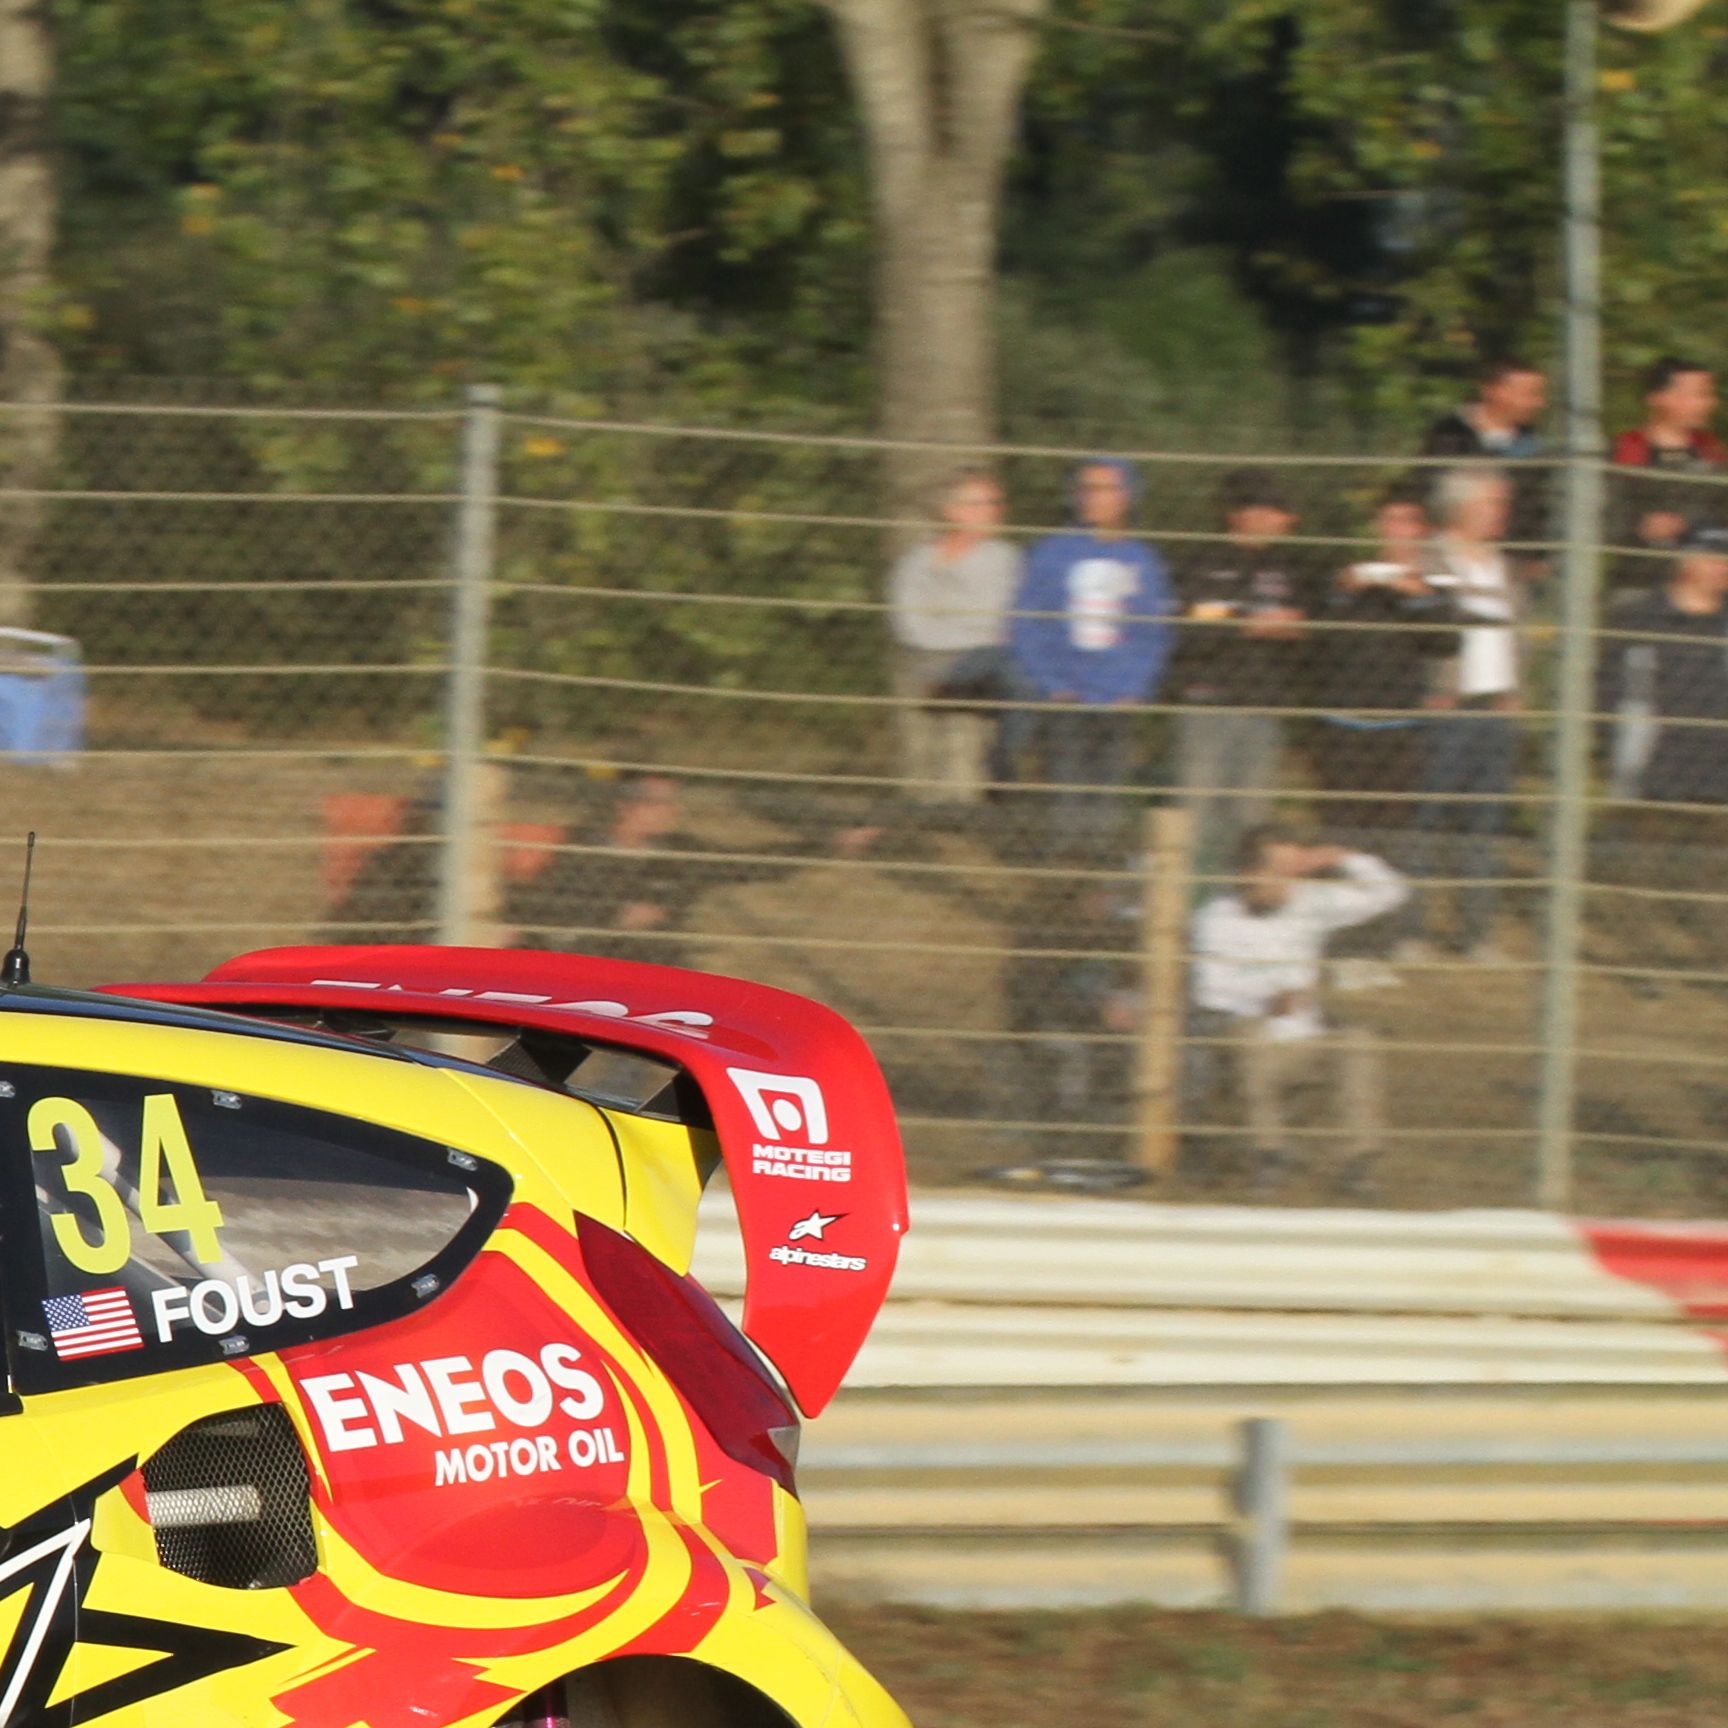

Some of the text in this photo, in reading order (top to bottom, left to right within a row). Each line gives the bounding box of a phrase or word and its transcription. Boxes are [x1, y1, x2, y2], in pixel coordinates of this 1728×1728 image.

[27, 1094, 224, 1274] 34
[752, 1143, 852, 1166] MOTEGI
[752, 1159, 852, 1182] RACING
[769, 1245, 867, 1271] alpinestars
[152, 1255, 359, 1343] FOUST
[300, 1343, 605, 1452] ENEOS
[434, 1427, 625, 1487] MOTOR OIL
